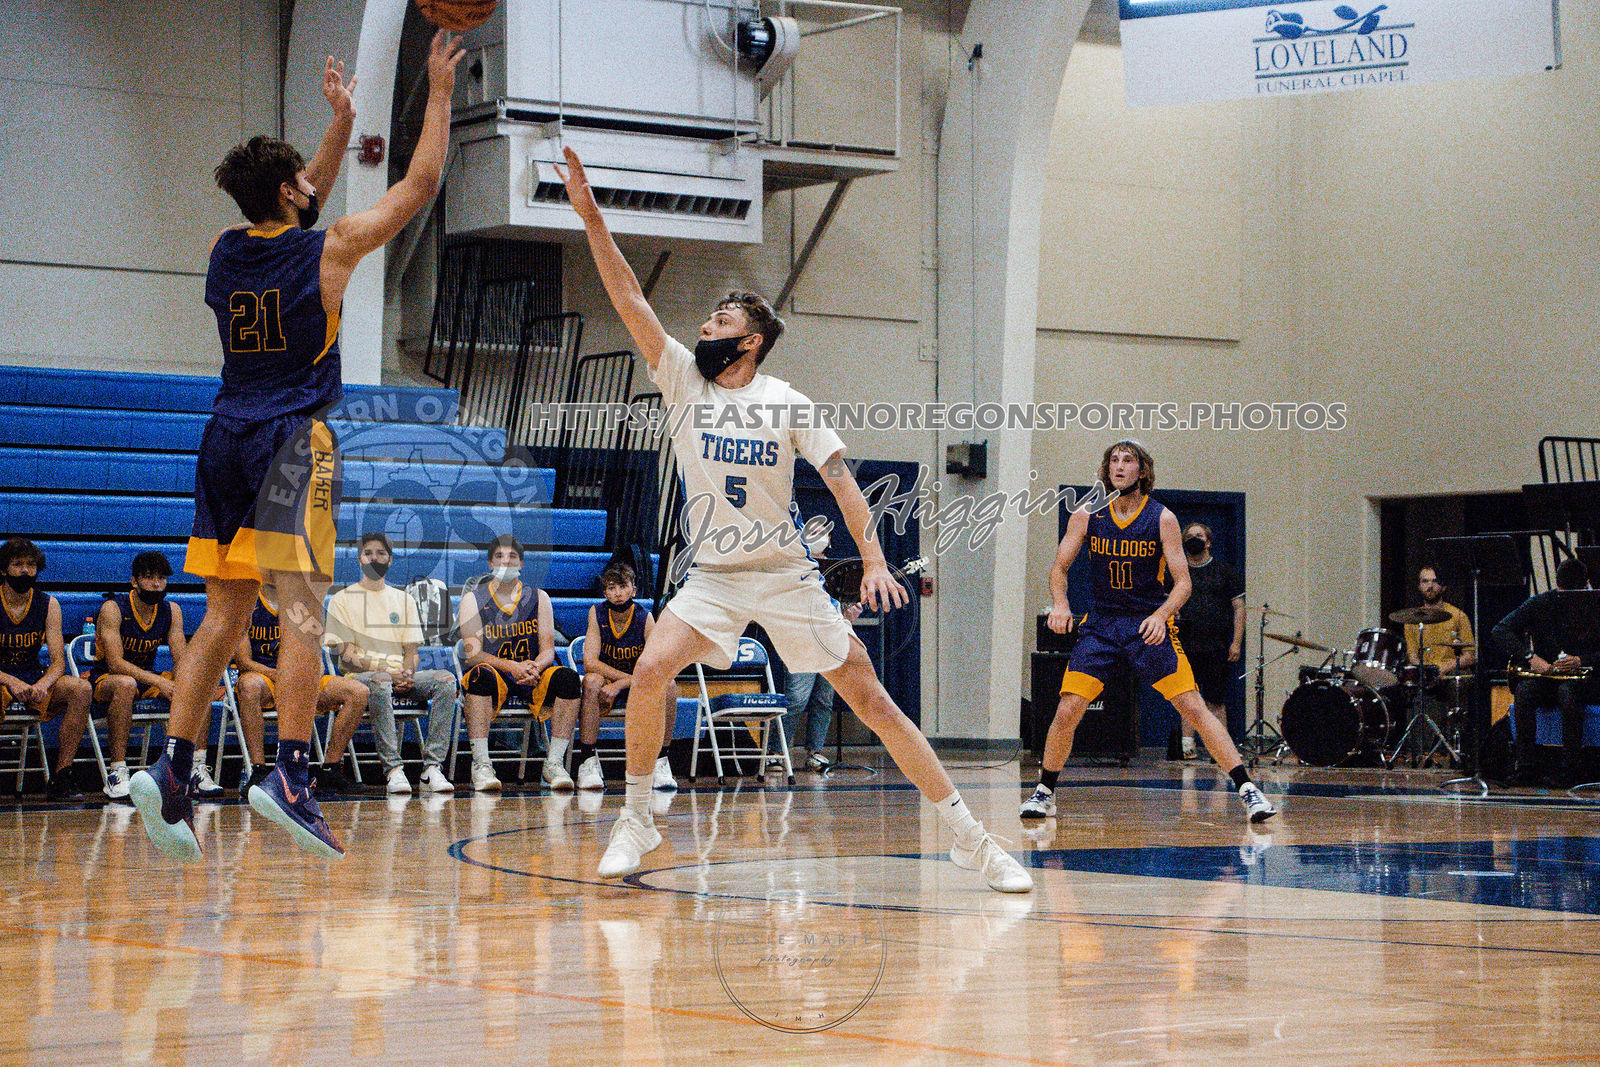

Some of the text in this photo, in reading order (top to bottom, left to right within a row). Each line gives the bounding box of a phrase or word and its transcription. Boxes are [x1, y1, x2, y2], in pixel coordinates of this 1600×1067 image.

[1255, 33, 1408, 72] LOVELAND
[1257, 69, 1410, 94] FUNERAL CHAPEL
[229, 288, 287, 353] 21
[701, 432, 779, 467] TIGERS
[313, 450, 334, 511] BAKER
[725, 475, 747, 508] 5
[1090, 535, 1157, 557] BULLDOGS
[1109, 560, 1133, 590] 11
[484, 618, 539, 640] BULLDOGS
[497, 638, 531, 661] 44
